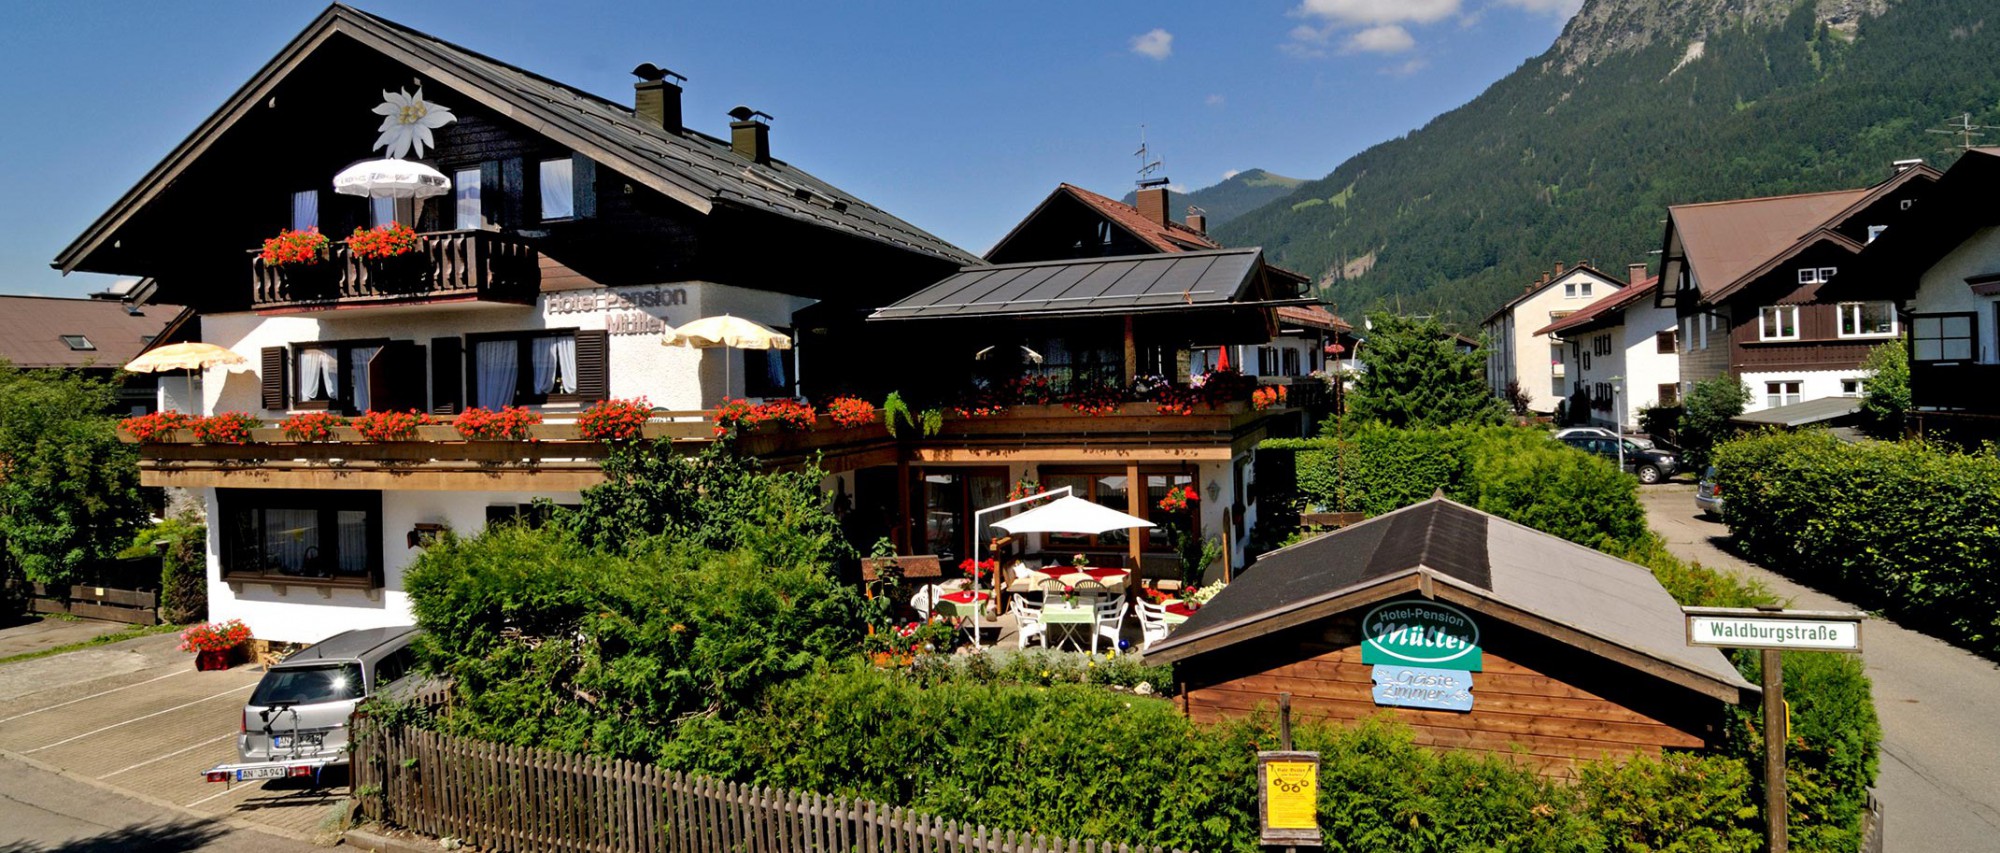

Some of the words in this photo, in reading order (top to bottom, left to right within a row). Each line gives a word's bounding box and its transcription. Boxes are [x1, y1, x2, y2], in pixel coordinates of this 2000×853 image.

[547, 292, 598, 314] Hotel
[605, 288, 687, 311] Pension
[605, 314, 669, 336] Müller
[1380, 608, 1464, 627] Hotel-Pension
[1373, 622, 1469, 650] Müller
[1710, 622, 1838, 642] Waldburgstraße
[1396, 670, 1460, 688] Gäste-
[1383, 684, 1445, 700] Zimmer
[258, 769, 268, 777] JA
[269, 768, 284, 776] 941
